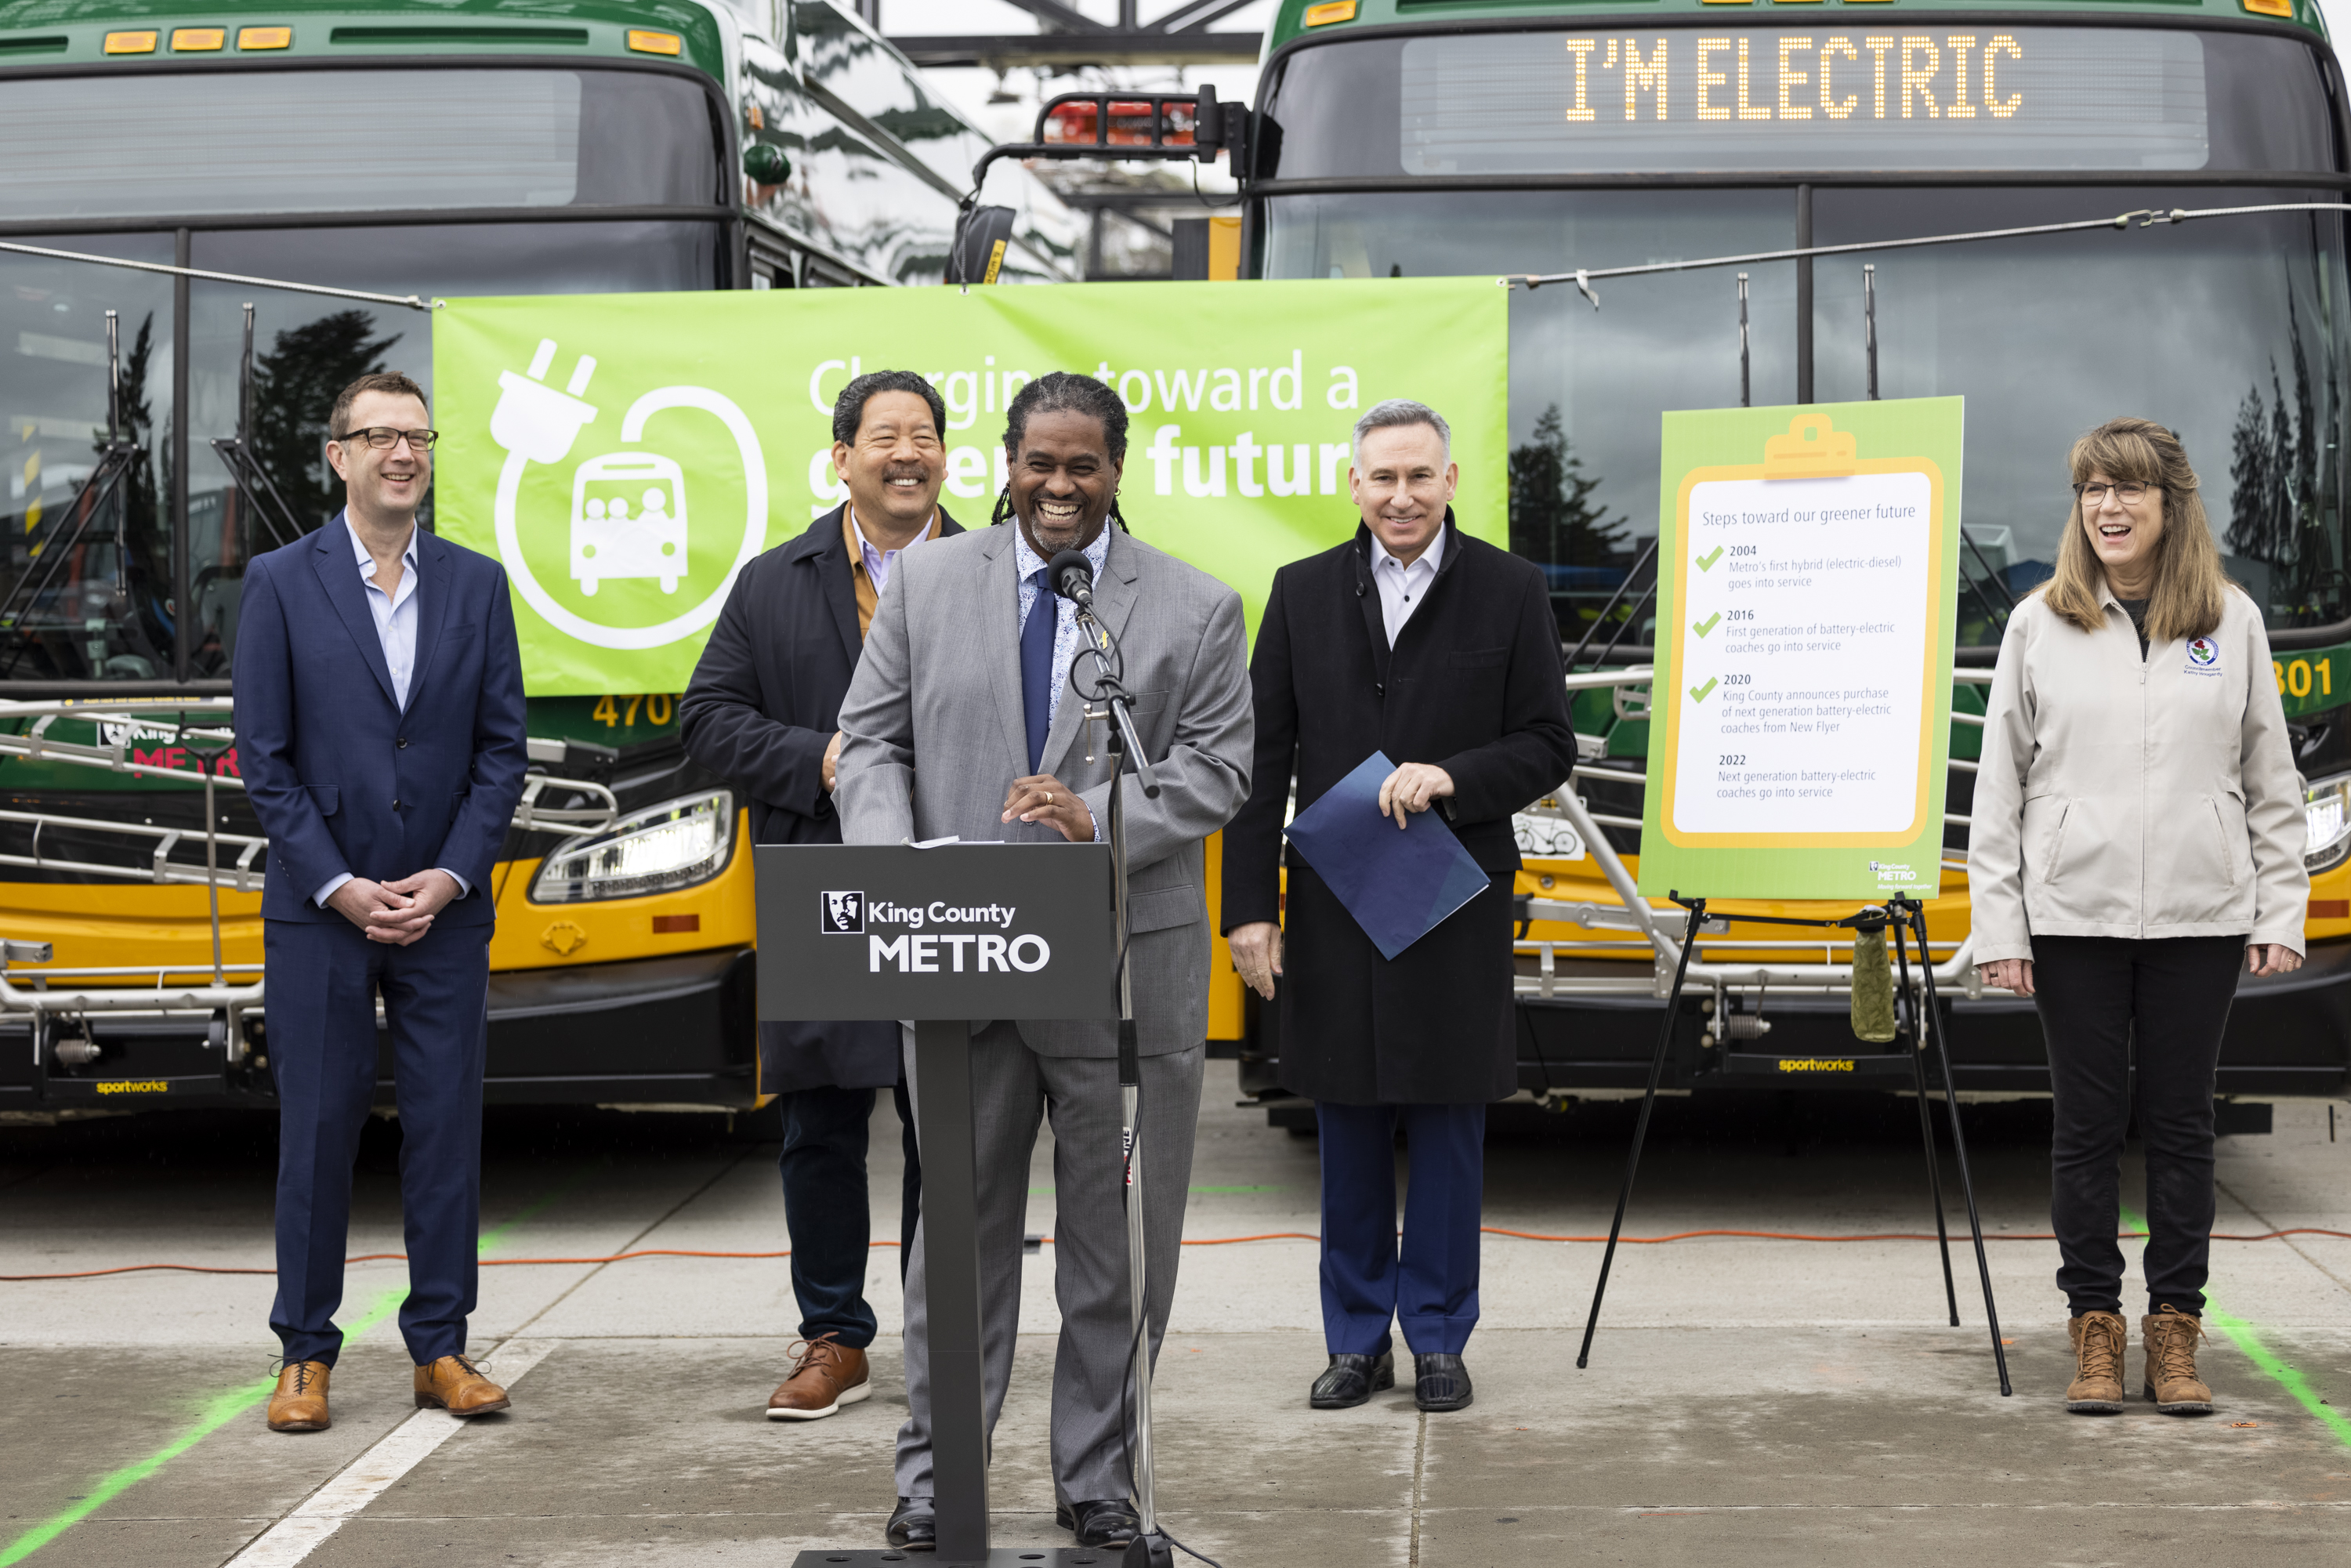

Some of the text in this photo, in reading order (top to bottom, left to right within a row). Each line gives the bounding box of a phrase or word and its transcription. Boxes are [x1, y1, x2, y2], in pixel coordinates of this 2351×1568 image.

[1567, 35, 2021, 121] I'M ELECTRIC
[1093, 349, 1302, 414] toward
[1327, 366, 1358, 410] a
[1147, 425, 1350, 498] futur
[1702, 503, 1916, 530] Steps toward our greener future
[1730, 545, 1757, 557] 2004
[1729, 555, 1902, 574] Metro's first hybrid (electric-diesel)
[1728, 575, 1812, 592] goes into service
[1726, 609, 1755, 621] 2016
[1726, 621, 1895, 640] First generation of battery-electric
[1725, 639, 1842, 656] coaches go into service
[1723, 673, 1751, 686] 2020
[1722, 686, 1889, 704] King County announces purchase
[592, 693, 684, 727] 470
[1722, 703, 1891, 719] of next generation battery-electric
[1720, 720, 1841, 735] coaches from New Flyer
[1719, 754, 1747, 766] 2022
[1718, 769, 1876, 785] Next generation battery-electric
[1716, 786, 1833, 801] coaches go into service
[1878, 871, 1917, 881] METRO
[868, 901, 1016, 929] King County
[869, 933, 1051, 972] METRO
[1779, 1058, 1854, 1073] sportworks
[96, 1080, 167, 1095] sportworks
